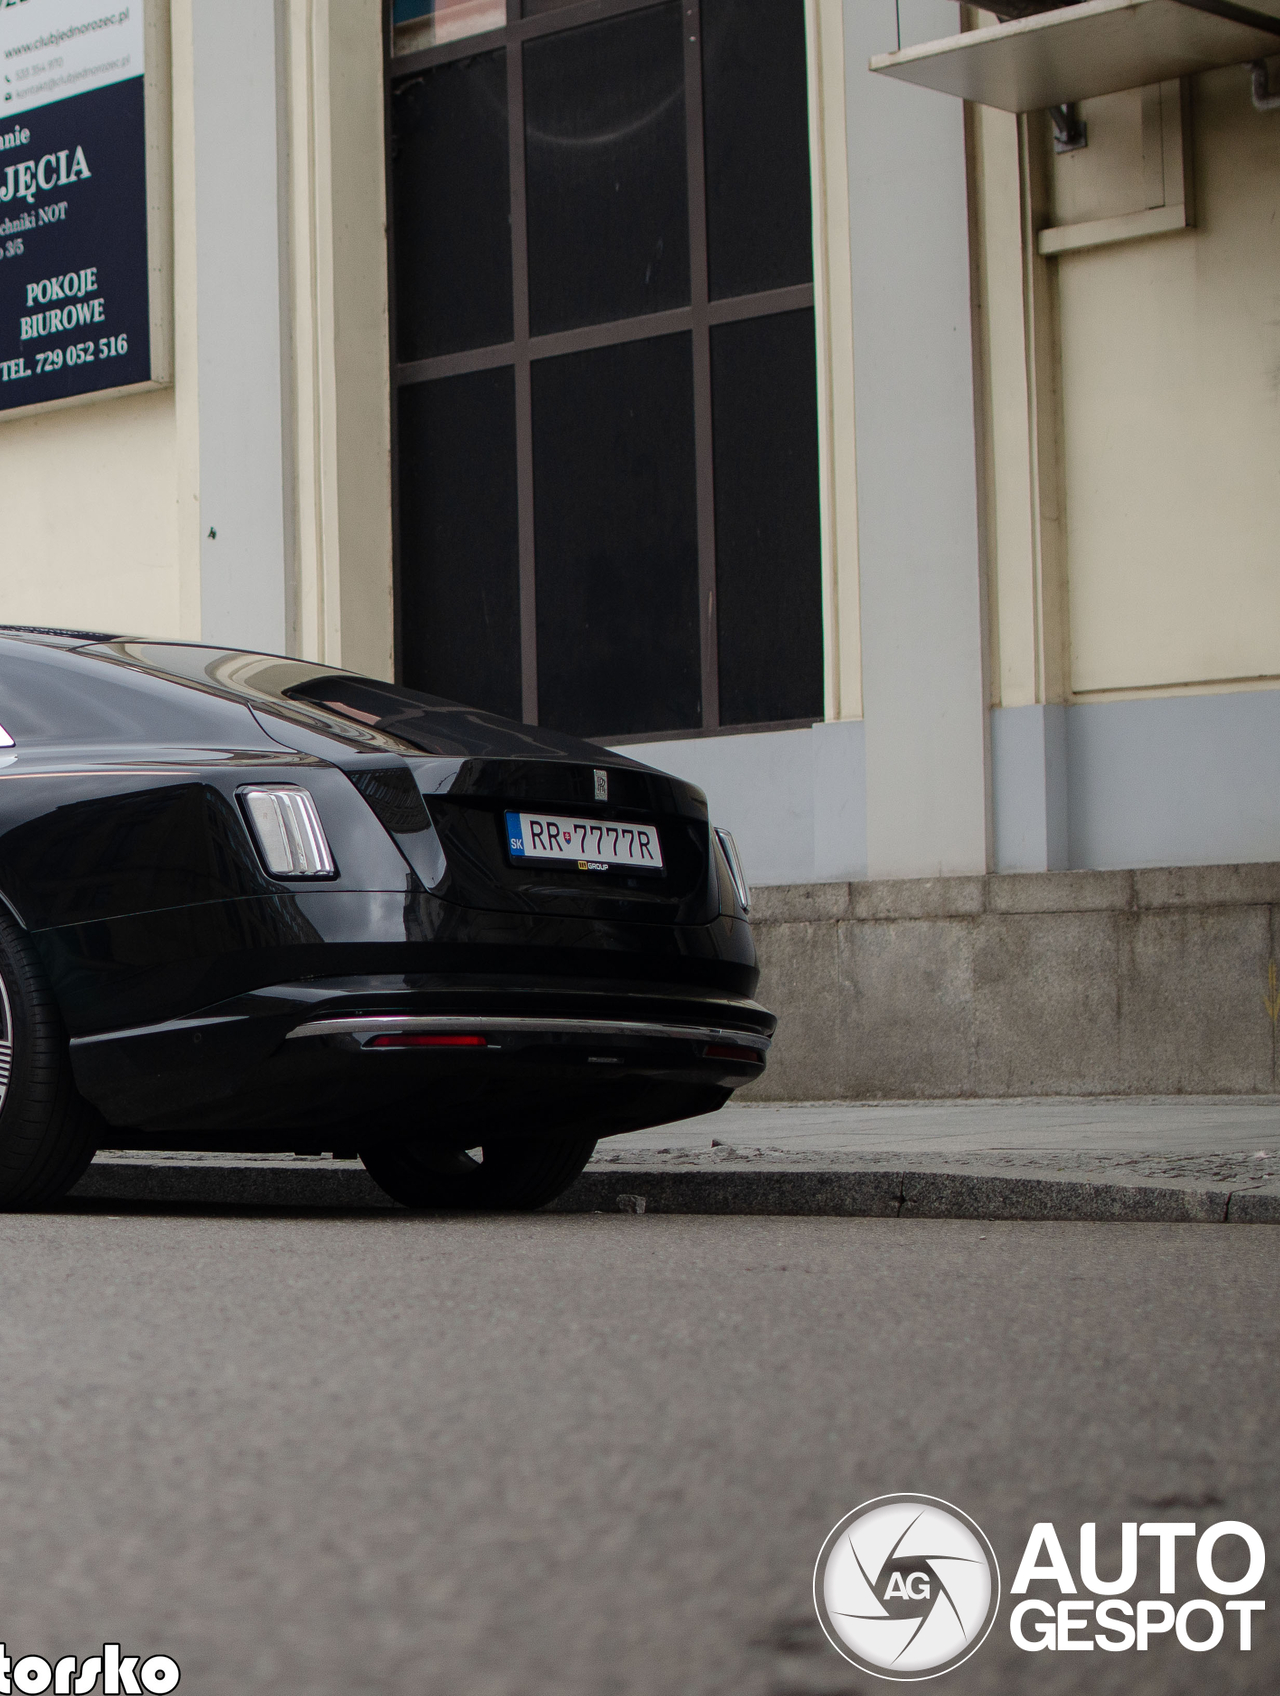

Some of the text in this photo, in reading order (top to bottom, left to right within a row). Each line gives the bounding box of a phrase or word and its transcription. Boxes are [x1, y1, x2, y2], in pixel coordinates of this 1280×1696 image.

[4, 7, 130, 59] www.clubjednorozec.pl
[38, 201, 69, 227] NOT
[6, 238, 25, 258] 3/5
[26, 267, 98, 307] POKOJE
[20, 298, 105, 341] BIUROWE
[0, 333, 128, 382] TEL. 729 052 516
[510, 838, 523, 850] SK
[529, 820, 654, 860] RR 7777R
